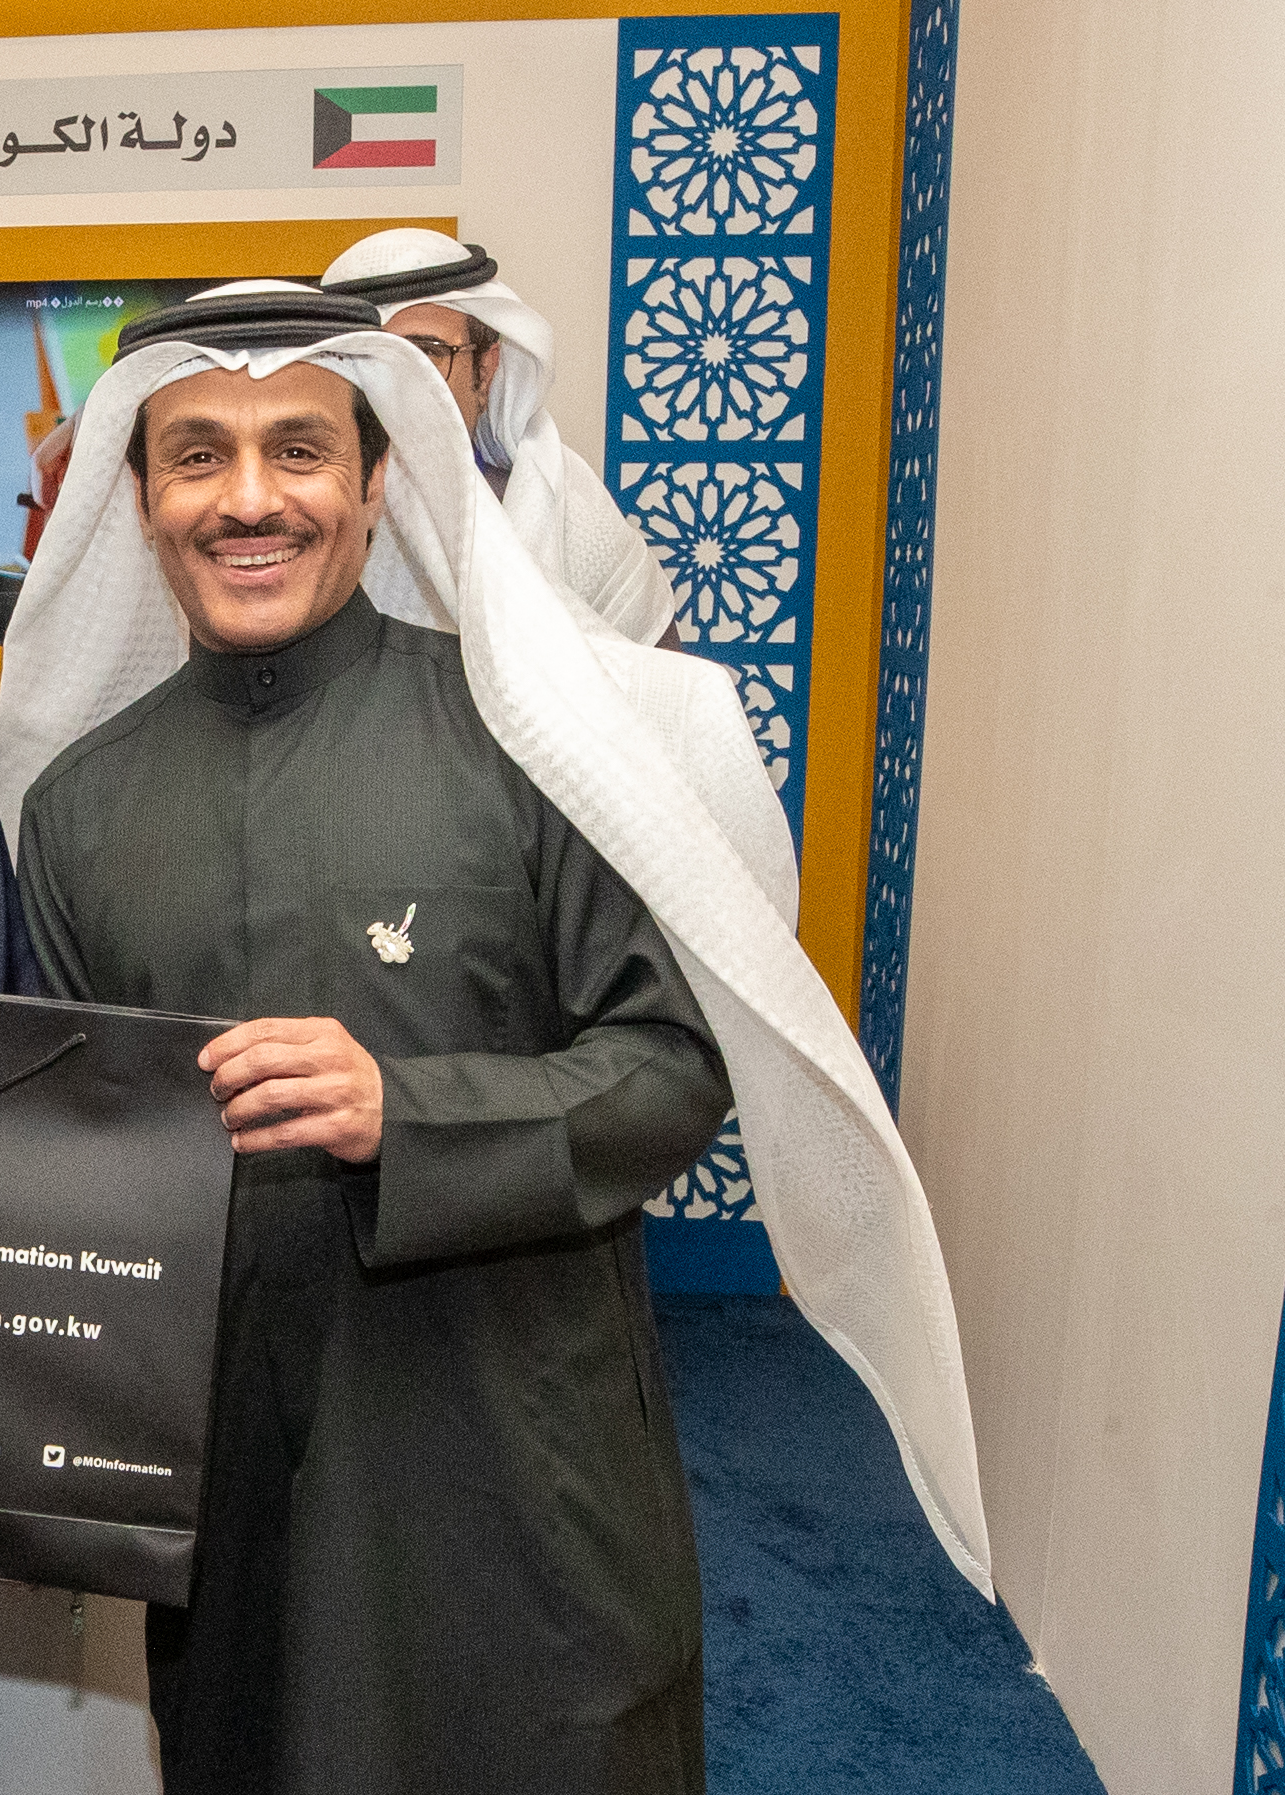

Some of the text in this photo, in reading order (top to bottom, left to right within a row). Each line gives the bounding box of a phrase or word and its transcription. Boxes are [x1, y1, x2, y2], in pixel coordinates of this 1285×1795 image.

[117, 111, 237, 162] دولة
[79, 1250, 163, 1281] Kuwait
[72, 1455, 173, 1477] @MOInformation
